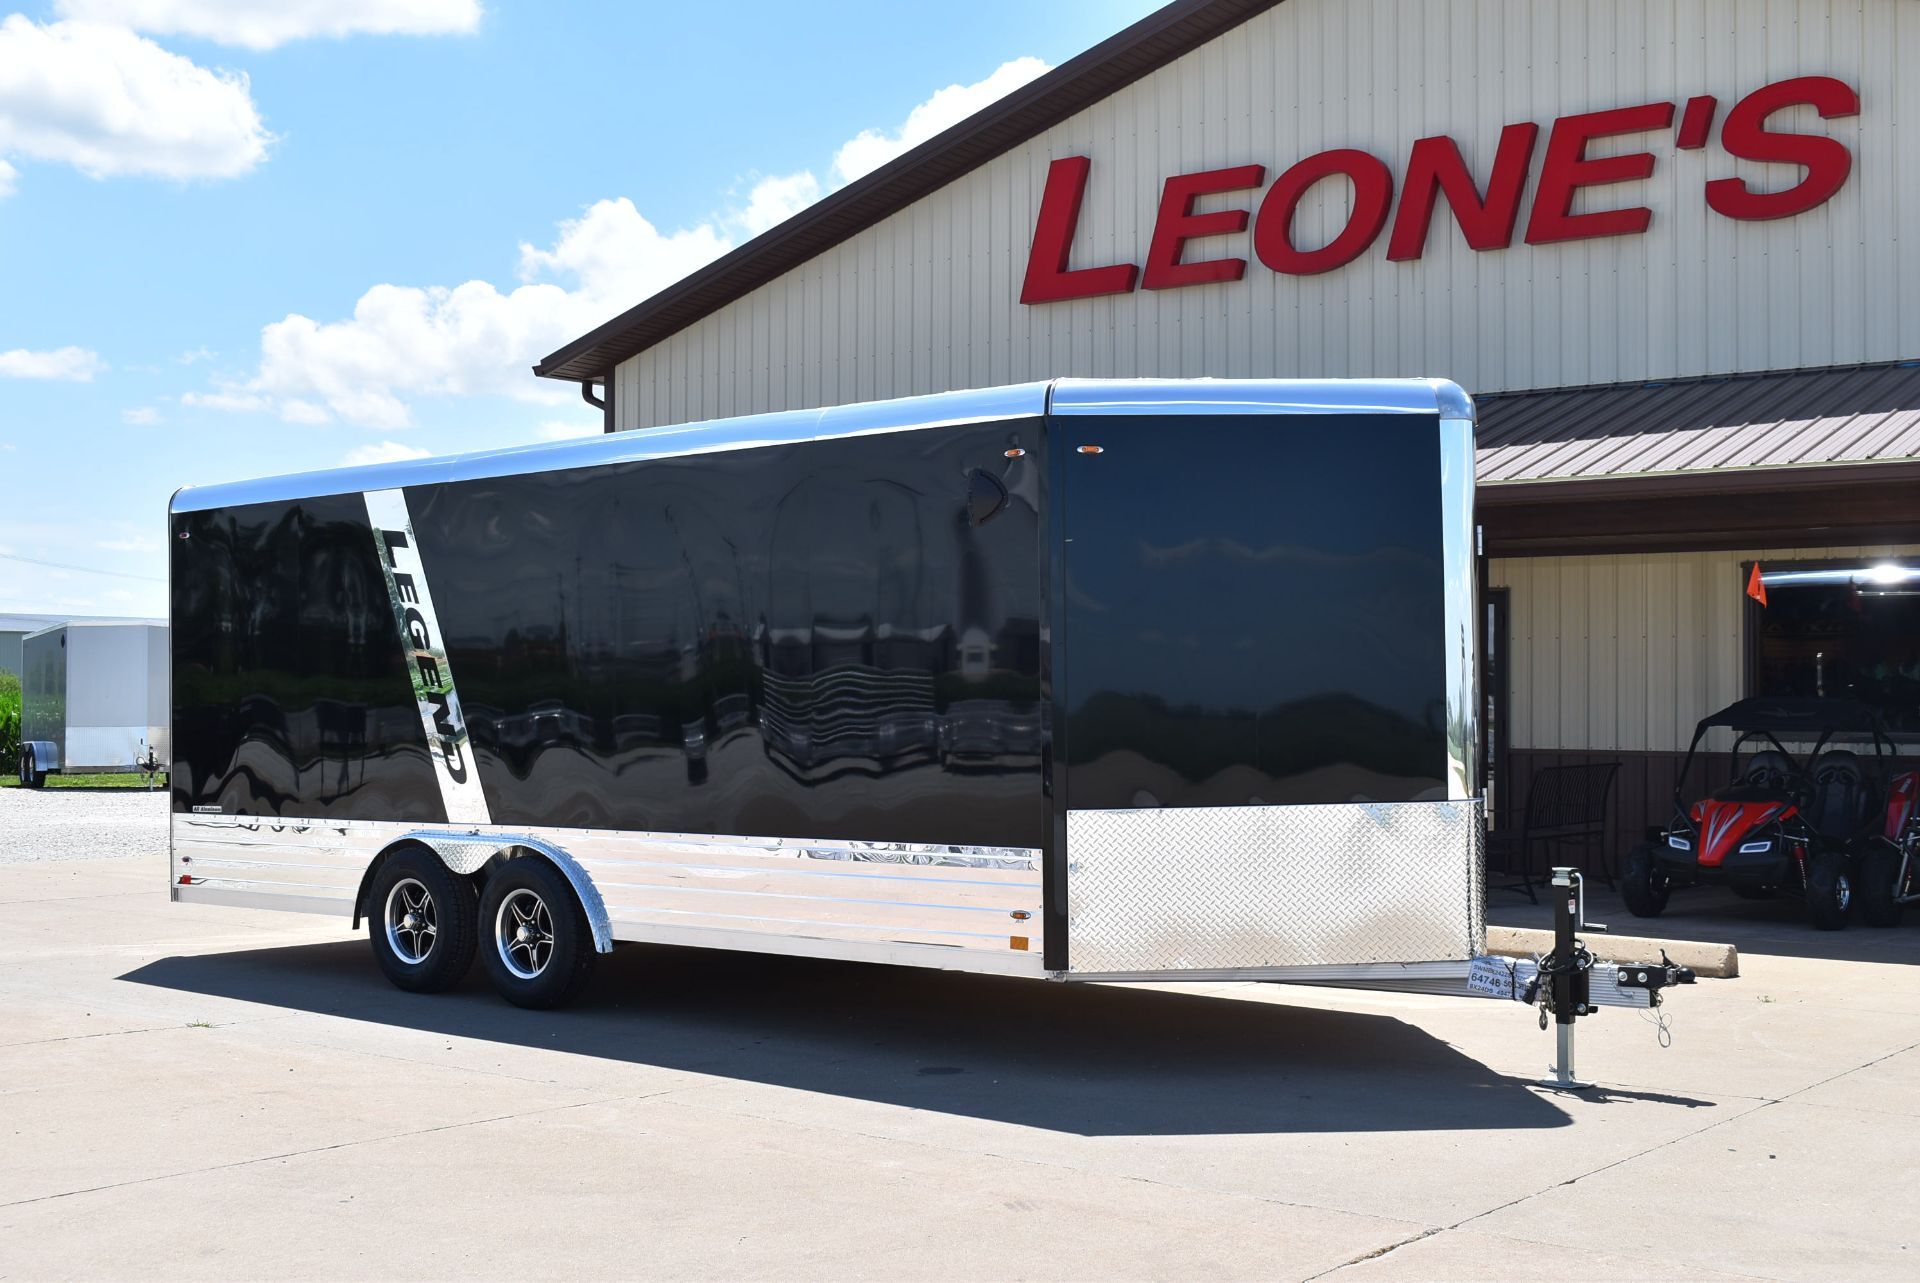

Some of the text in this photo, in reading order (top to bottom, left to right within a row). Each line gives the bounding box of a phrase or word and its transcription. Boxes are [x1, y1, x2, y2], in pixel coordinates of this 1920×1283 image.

[1020, 76, 1860, 305] LEONE'S
[382, 529, 467, 785] LEGEND
[1471, 972, 1501, 987] 64746
